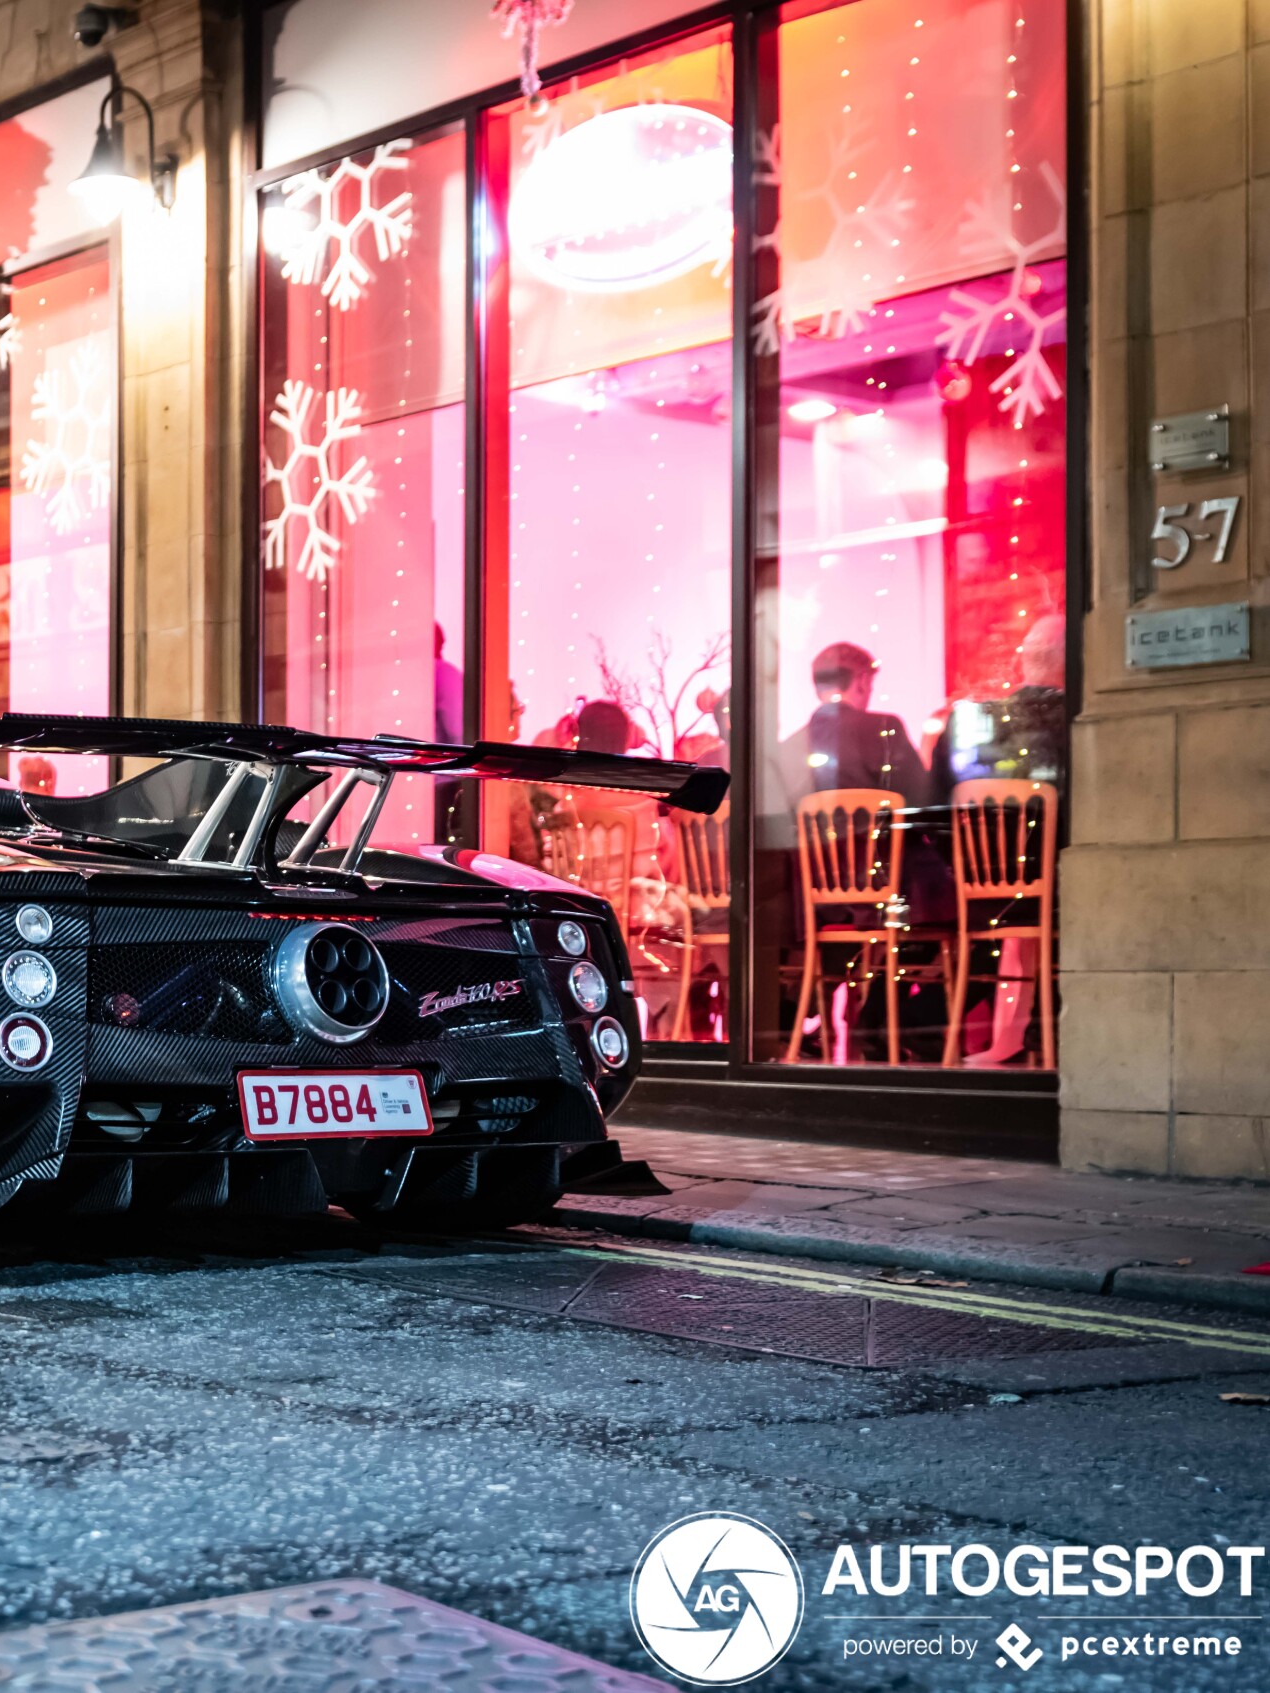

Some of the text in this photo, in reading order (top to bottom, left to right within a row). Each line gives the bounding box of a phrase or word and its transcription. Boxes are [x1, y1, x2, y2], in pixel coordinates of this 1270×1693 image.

[1150, 496, 1241, 569] 5-7
[1131, 619, 1240, 646] icetank
[252, 1084, 377, 1126] B7884
